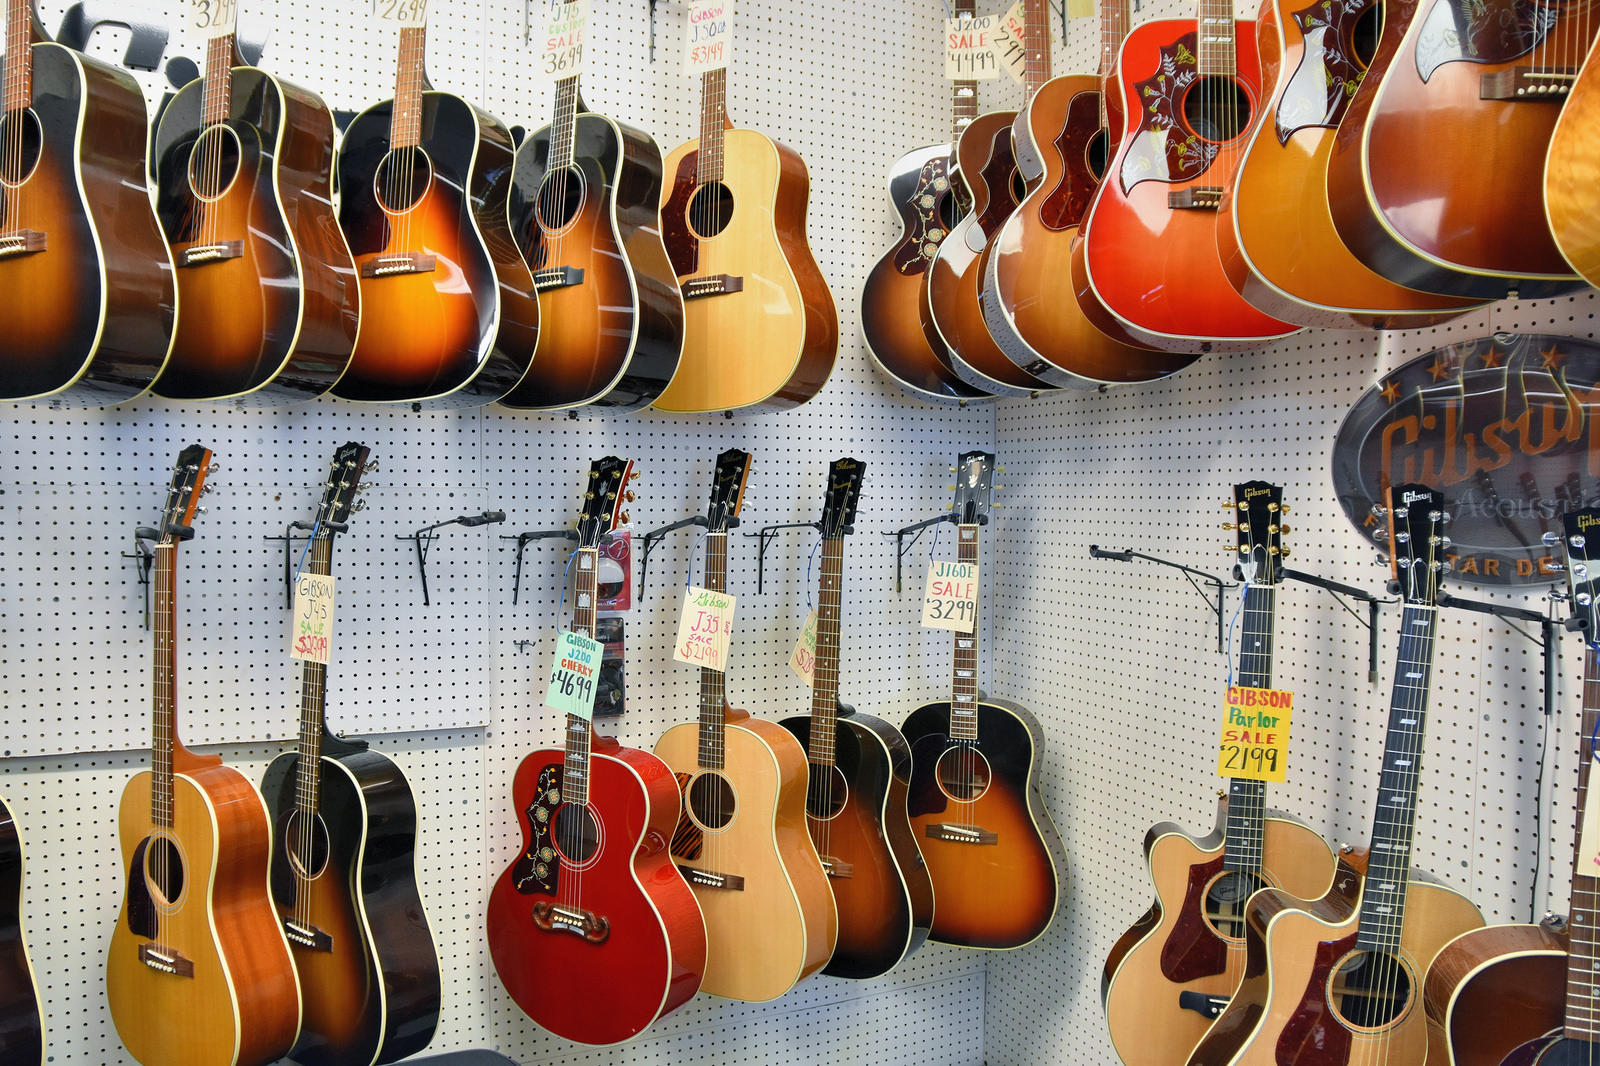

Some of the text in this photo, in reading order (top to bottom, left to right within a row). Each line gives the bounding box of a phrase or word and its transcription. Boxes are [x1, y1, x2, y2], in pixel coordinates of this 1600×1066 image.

[953, 17, 991, 32] J200
[546, 30, 583, 51] SALE
[948, 31, 989, 49] SALE
[1244, 487, 1272, 501] Gibson
[1402, 490, 1433, 508] Gibson
[1577, 513, 1600, 533] Gibs
[936, 562, 975, 578] J160E
[300, 578, 332, 599] GIBSON
[931, 581, 974, 599] SALE
[304, 599, 327, 619] J45
[301, 621, 324, 635] SALE
[690, 610, 720, 634] J35
[566, 634, 597, 652] GIBSON
[567, 648, 592, 664] J200
[561, 658, 594, 678] CHERRY
[550, 669, 593, 704] $4699
[1227, 687, 1291, 708] GIBSON
[1229, 707, 1280, 728] Parlor
[1224, 731, 1277, 744] SALE
